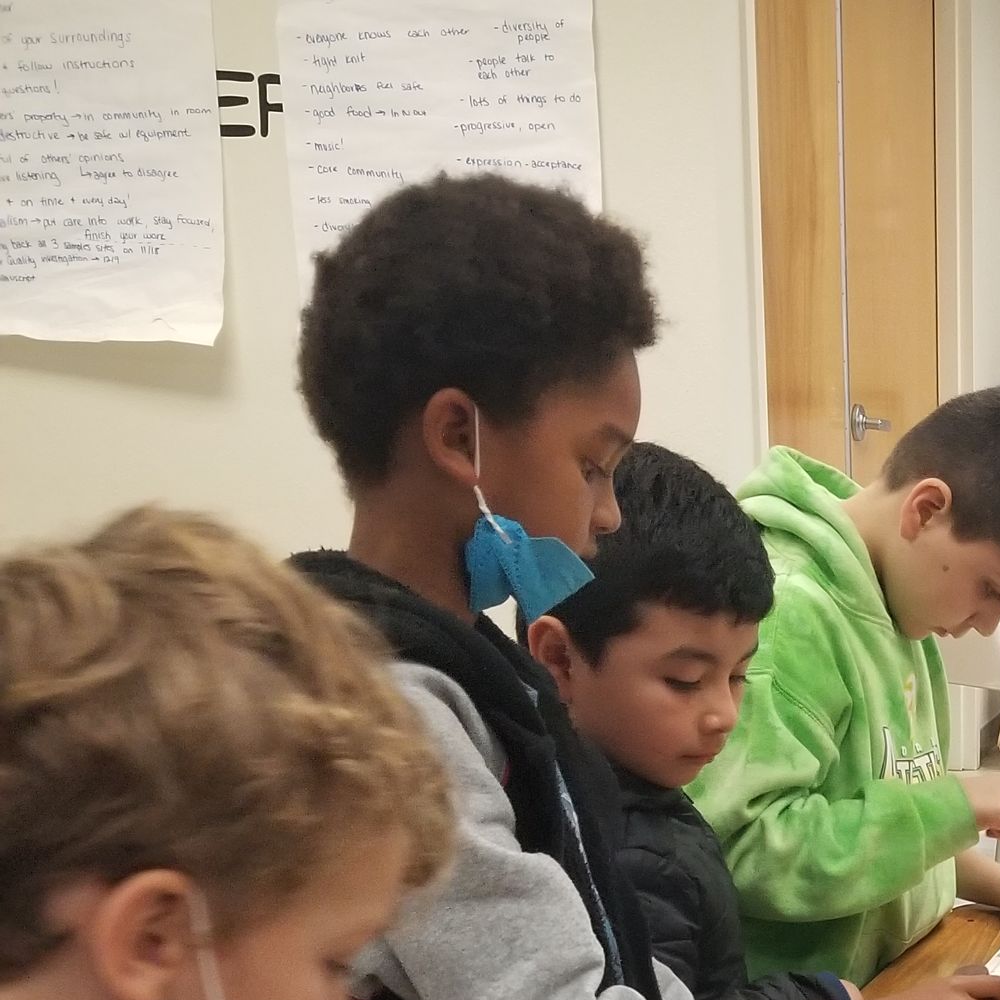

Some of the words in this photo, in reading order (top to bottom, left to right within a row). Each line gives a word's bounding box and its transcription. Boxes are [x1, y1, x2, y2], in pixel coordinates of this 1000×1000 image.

[502, 19, 548, 34] diversity
[555, 19, 564, 29] of
[305, 31, 348, 48] everyone
[358, 30, 391, 40] knows
[408, 28, 430, 38] each
[440, 27, 470, 37] other
[517, 32, 550, 44] people
[18, 60, 53, 72] follow
[62, 59, 135, 70] instructions
[312, 54, 337, 74] tight
[345, 52, 365, 64] knit
[476, 55, 506, 70] people
[515, 53, 536, 63] talk
[544, 54, 554, 62] to
[478, 68, 498, 80] each
[505, 67, 531, 78] other
[401, 83, 424, 91] safe
[470, 94, 490, 108] lots
[498, 94, 507, 105] of
[516, 93, 547, 108] things
[554, 94, 566, 104] to
[569, 93, 581, 103] do
[102, 110, 162, 123] community
[170, 108, 180, 116] in
[313, 106, 336, 125] good
[346, 106, 372, 118] food
[528, 122, 556, 132] open
[136, 128, 191, 142] equipment
[314, 137, 344, 152] music!
[79, 152, 125, 164] opinions
[465, 157, 521, 169] expression
[531, 160, 582, 171] acceptance
[122, 170, 134, 178] to
[137, 168, 179, 182] disagree
[347, 166, 404, 185] community
[63, 218, 83, 227] care
[87, 215, 108, 226] into
[153, 216, 174, 230] stay
[84, 229, 111, 241] finish
[120, 233, 138, 244] your
